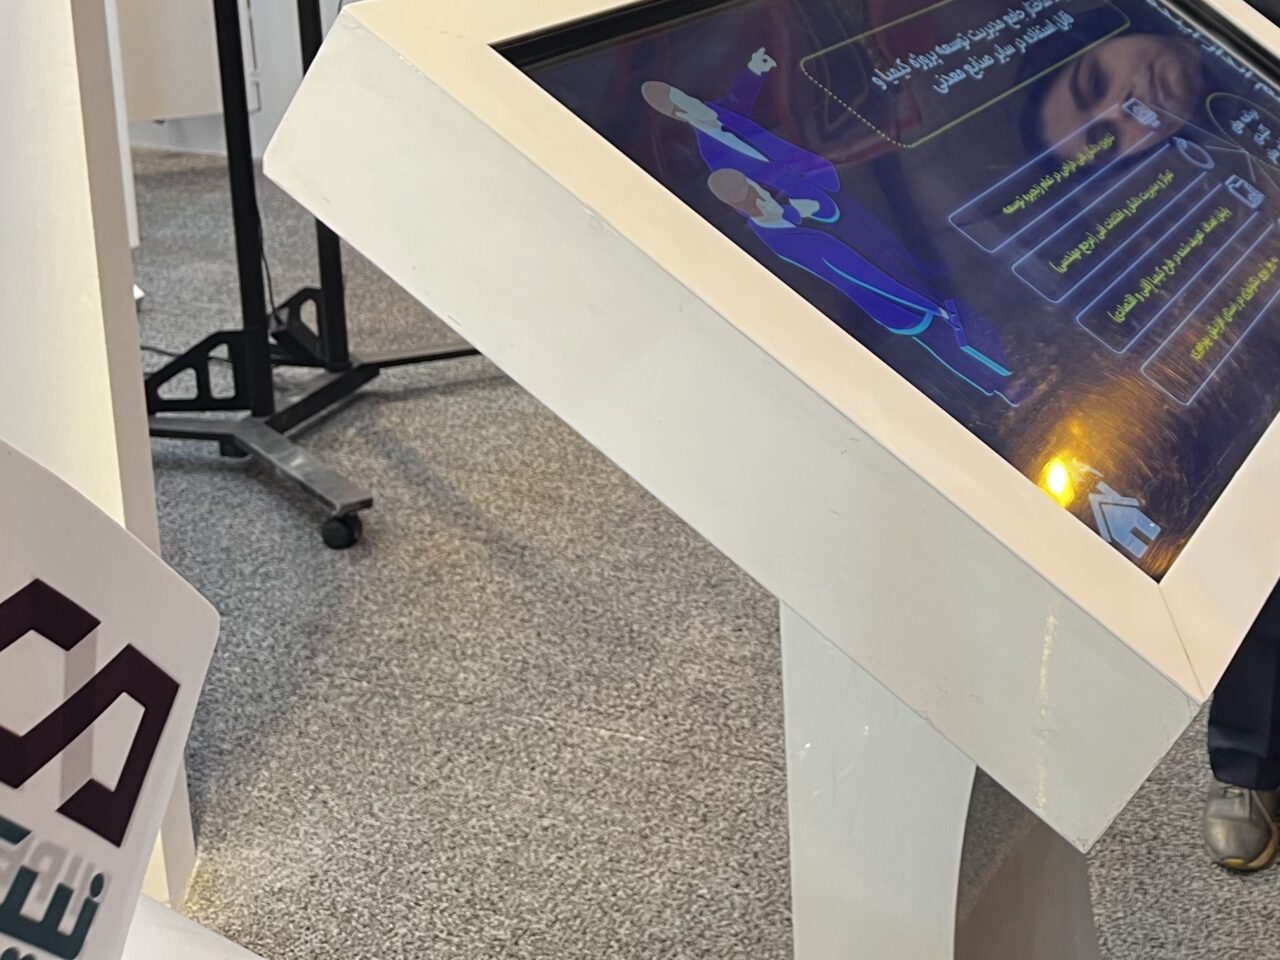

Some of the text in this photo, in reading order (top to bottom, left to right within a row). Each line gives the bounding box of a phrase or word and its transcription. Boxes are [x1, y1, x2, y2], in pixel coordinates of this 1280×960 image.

[1002, 8, 1025, 29] جامع
[967, 19, 1005, 40] مدیریت
[933, 10, 1074, 93] قابل استفاده در سایر صنایع معدنی
[935, 33, 970, 54] توسعه
[908, 51, 943, 70] پروژه
[874, 58, 911, 84] کیمیا
[871, 76, 887, 90] و
[1083, 144, 1101, 160] دانش
[1040, 175, 1054, 190] تمام
[1053, 172, 1061, 182] در
[1022, 185, 1044, 202] زنجیره
[1139, 183, 1159, 200] مدیریت
[1002, 198, 1025, 213] توسعه
[1122, 208, 1131, 216] و
[1126, 197, 1142, 212] دانش
[1097, 224, 1107, 239] فنی
[1078, 232, 1098, 254] (مرجع
[1177, 243, 1191, 257] شده
[1049, 248, 1081, 272] مهندسی)
[1162, 259, 1175, 274] طرح
[1173, 254, 1181, 264] در
[1147, 266, 1165, 284] کیمیا
[1140, 278, 1155, 296] (فنی
[1134, 292, 1144, 301] و
[1108, 294, 1137, 322] اقتصادی)
